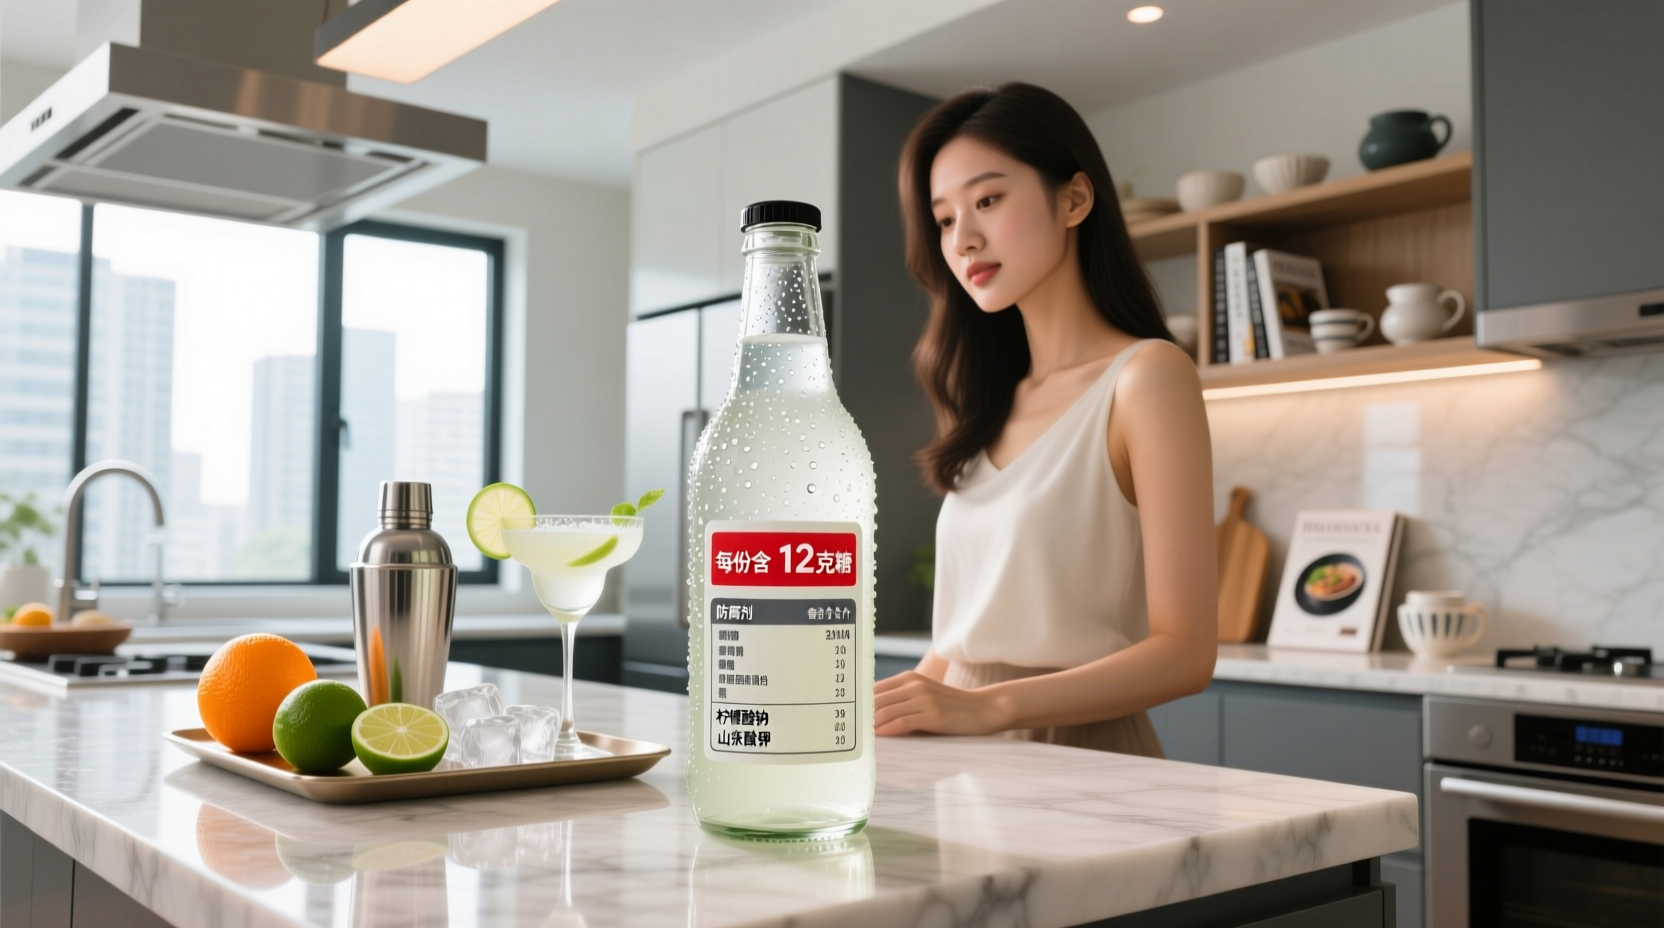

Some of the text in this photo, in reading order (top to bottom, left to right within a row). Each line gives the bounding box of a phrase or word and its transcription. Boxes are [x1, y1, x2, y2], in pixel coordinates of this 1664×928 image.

[716, 543, 852, 574] 每份含 12克糖
